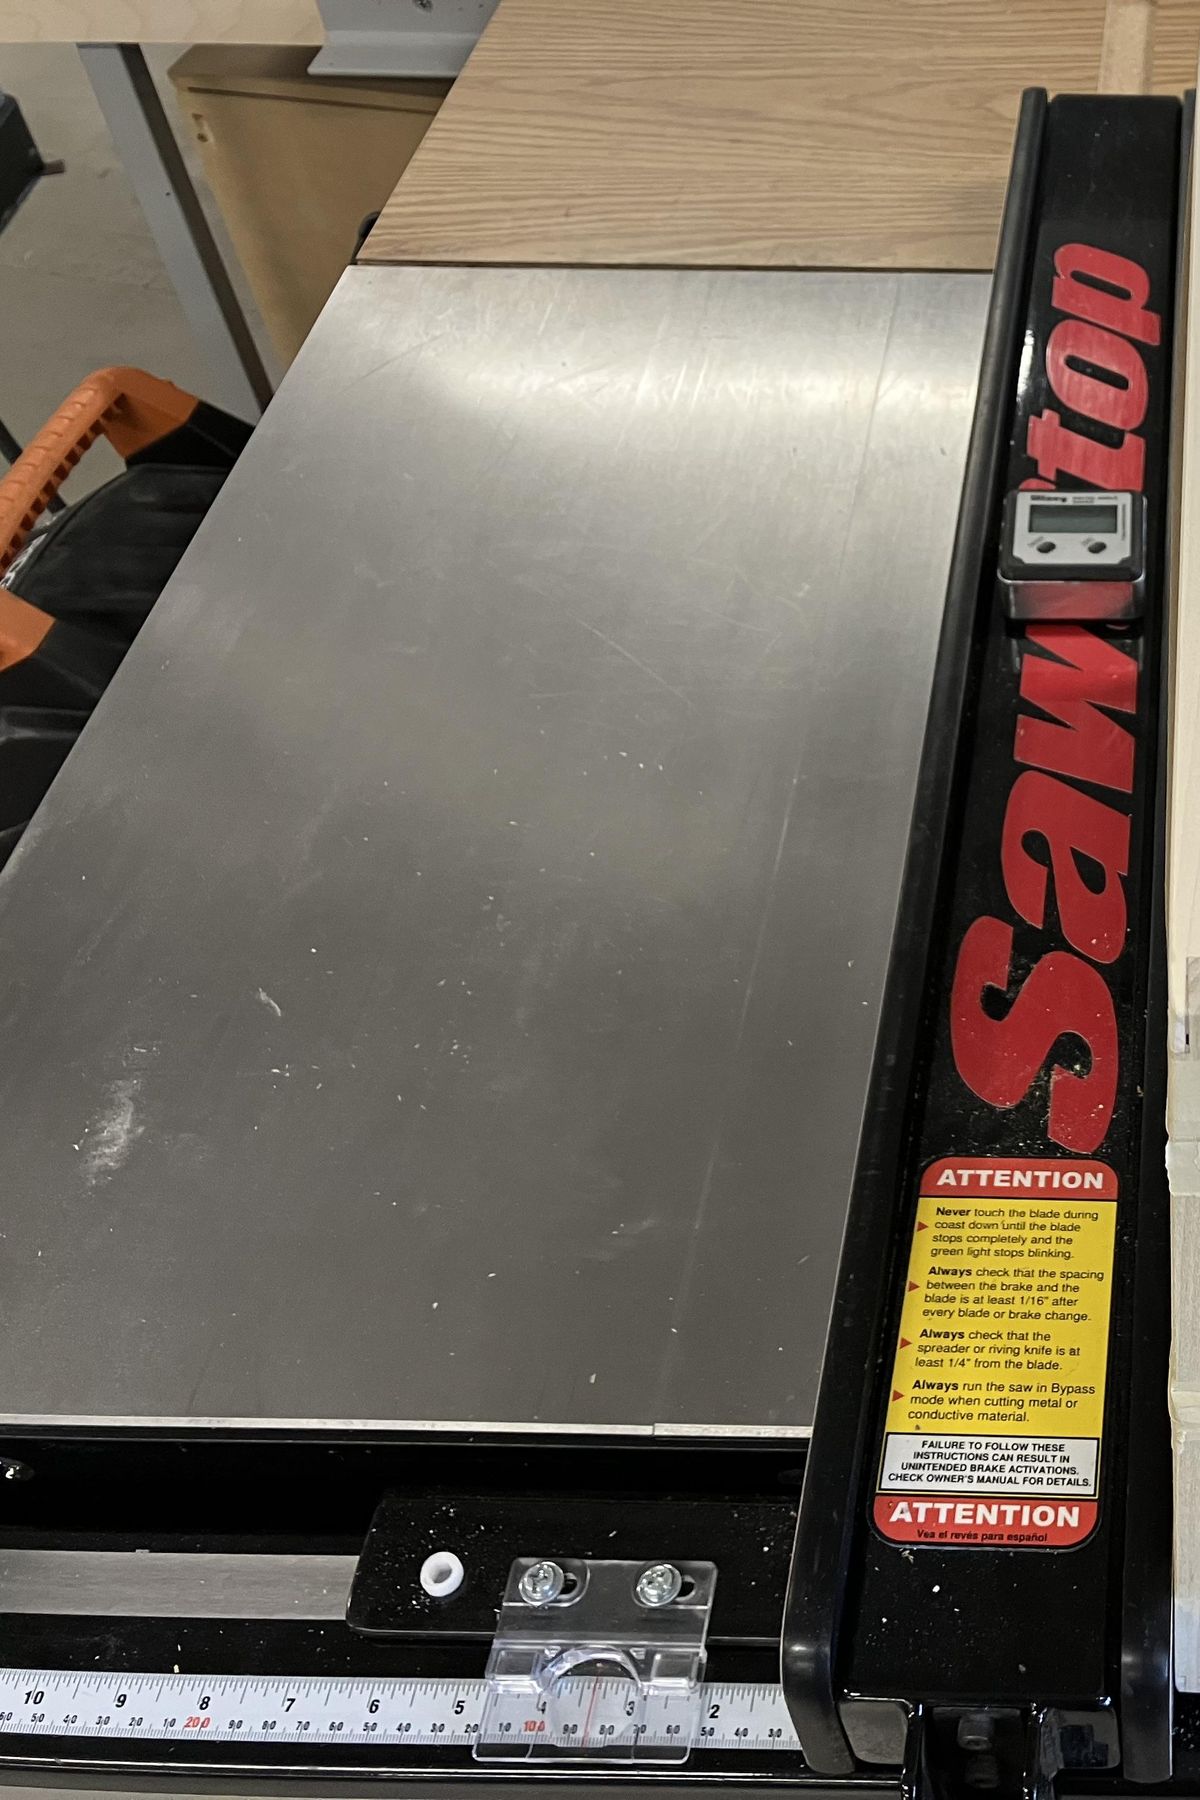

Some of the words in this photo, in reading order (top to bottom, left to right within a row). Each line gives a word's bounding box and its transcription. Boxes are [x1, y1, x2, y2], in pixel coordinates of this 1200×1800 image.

[950, 242, 1162, 1156] Sawtop
[936, 1169, 1103, 1189] ATTENTION
[936, 1207, 970, 1217] Never
[974, 1208, 1005, 1217] touch
[1009, 1209, 1026, 1217] the
[1029, 1210, 1060, 1219] blade
[1064, 1210, 1098, 1220] during
[934, 1221, 965, 1229] coast
[968, 1221, 998, 1230] down
[1002, 1222, 1025, 1230] until
[1029, 1222, 1046, 1231] the
[1050, 1223, 1081, 1231] blade
[932, 1234, 962, 1244] stops
[966, 1235, 1027, 1245] completely
[1030, 1235, 1052, 1244] and
[1055, 1236, 1073, 1244] the
[930, 1247, 963, 1257] green
[966, 1247, 991, 1257] light
[993, 1248, 1024, 1259] stops
[1028, 1249, 1075, 1259] blinking.
[929, 1267, 972, 1278] Always
[976, 1268, 1009, 1277] check
[1013, 1269, 1035, 1278] that
[1038, 1269, 1056, 1278] the
[1059, 1271, 1104, 1280] spacing
[926, 1280, 975, 1290] between
[979, 1281, 996, 1290] the
[1000, 1282, 1032, 1291] brake
[1036, 1283, 1058, 1292] and
[1062, 1283, 1079, 1292] the
[924, 1294, 956, 1303] blade
[960, 1294, 969, 1303] is
[973, 1295, 984, 1303] at
[987, 1295, 1015, 1304] least
[1052, 1296, 1078, 1306] after
[922, 1309, 954, 1318] every
[958, 1309, 990, 1318] blade
[993, 1310, 1005, 1318] or
[1009, 1310, 1041, 1319] brake
[1045, 1311, 1091, 1322] change.
[920, 1329, 965, 1340] Always
[968, 1330, 1003, 1340] check
[1007, 1331, 1029, 1340] that
[1032, 1331, 1051, 1340] the
[917, 1344, 969, 1354] spreader
[973, 1345, 985, 1354] or
[988, 1345, 1020, 1356] riving
[1024, 1346, 1052, 1355] knife
[1055, 1347, 1065, 1355] is
[1069, 1347, 1080, 1356] at
[915, 1358, 943, 1368] least
[974, 1359, 1000, 1369] from
[1004, 1360, 1022, 1369] the
[1026, 1361, 1063, 1370] blade.
[912, 1380, 959, 1391] Always
[962, 1383, 982, 1391] run
[986, 1382, 1005, 1392] the
[1008, 1384, 1033, 1392] saw
[1037, 1383, 1047, 1392] in
[1052, 1383, 1095, 1395] Bypass
[910, 1395, 944, 1405] mode
[948, 1396, 980, 1406] when
[984, 1397, 1024, 1408] cutting
[1029, 1398, 1061, 1408] metal
[1065, 1400, 1078, 1408] or
[908, 1410, 973, 1421] conductive
[977, 1411, 1029, 1422] material.
[921, 1441, 965, 1449] FAILURE
[969, 1441, 982, 1449] TO
[985, 1442, 1028, 1451] FOLLOW
[1032, 1443, 1065, 1452] THESE
[913, 1452, 989, 1461] INSTRUCTIONS
[992, 1453, 1013, 1461] CAN
[1016, 1454, 1056, 1463] RESULT
[1059, 1455, 1070, 1463] IN
[901, 1463, 967, 1472] UNINTENDED
[970, 1464, 1005, 1473] BRAKE
[1008, 1465, 1078, 1475] ACTIVATIONS.
[888, 1473, 923, 1482] CHECK
[926, 1474, 974, 1483] OWNER'S
[977, 1475, 1019, 1484] MANUAL
[1022, 1476, 1044, 1485] FOR
[1046, 1477, 1091, 1486] DETAILS.
[889, 1502, 1079, 1527] ATTENTION
[917, 1530, 936, 1538] Vea
[940, 1530, 947, 1539] el
[950, 1531, 978, 1541] revés
[981, 1533, 1003, 1542] para
[1007, 1533, 1047, 1542] español
[24, 1691, 45, 1704] 10
[116, 1694, 127, 1707] 9
[199, 1696, 211, 1710] 8
[285, 1698, 296, 1712] 7
[369, 1699, 380, 1713] 6
[454, 1700, 465, 1714] 5
[626, 1701, 635, 1716] 3
[709, 1704, 720, 1718] 2
[31, 1713, 45, 1723] 50
[63, 1714, 77, 1724] 40
[96, 1716, 110, 1725] 30
[129, 1717, 143, 1726] 20
[163, 1718, 176, 1727] 10
[184, 1716, 210, 1728] 200
[228, 1720, 243, 1729] 90
[262, 1721, 276, 1730] 80
[297, 1721, 310, 1730] 70
[329, 1722, 343, 1731] 60
[363, 1722, 377, 1732] 50
[396, 1723, 411, 1732] 40
[431, 1723, 445, 1733] 30
[499, 1723, 511, 1732] 10
[524, 1721, 545, 1732] 100
[563, 1724, 577, 1734] 90
[600, 1725, 614, 1735] 80
[666, 1725, 680, 1734] 60
[700, 1727, 714, 1736] 50
[734, 1727, 748, 1737] 40
[768, 1728, 782, 1738] 30
